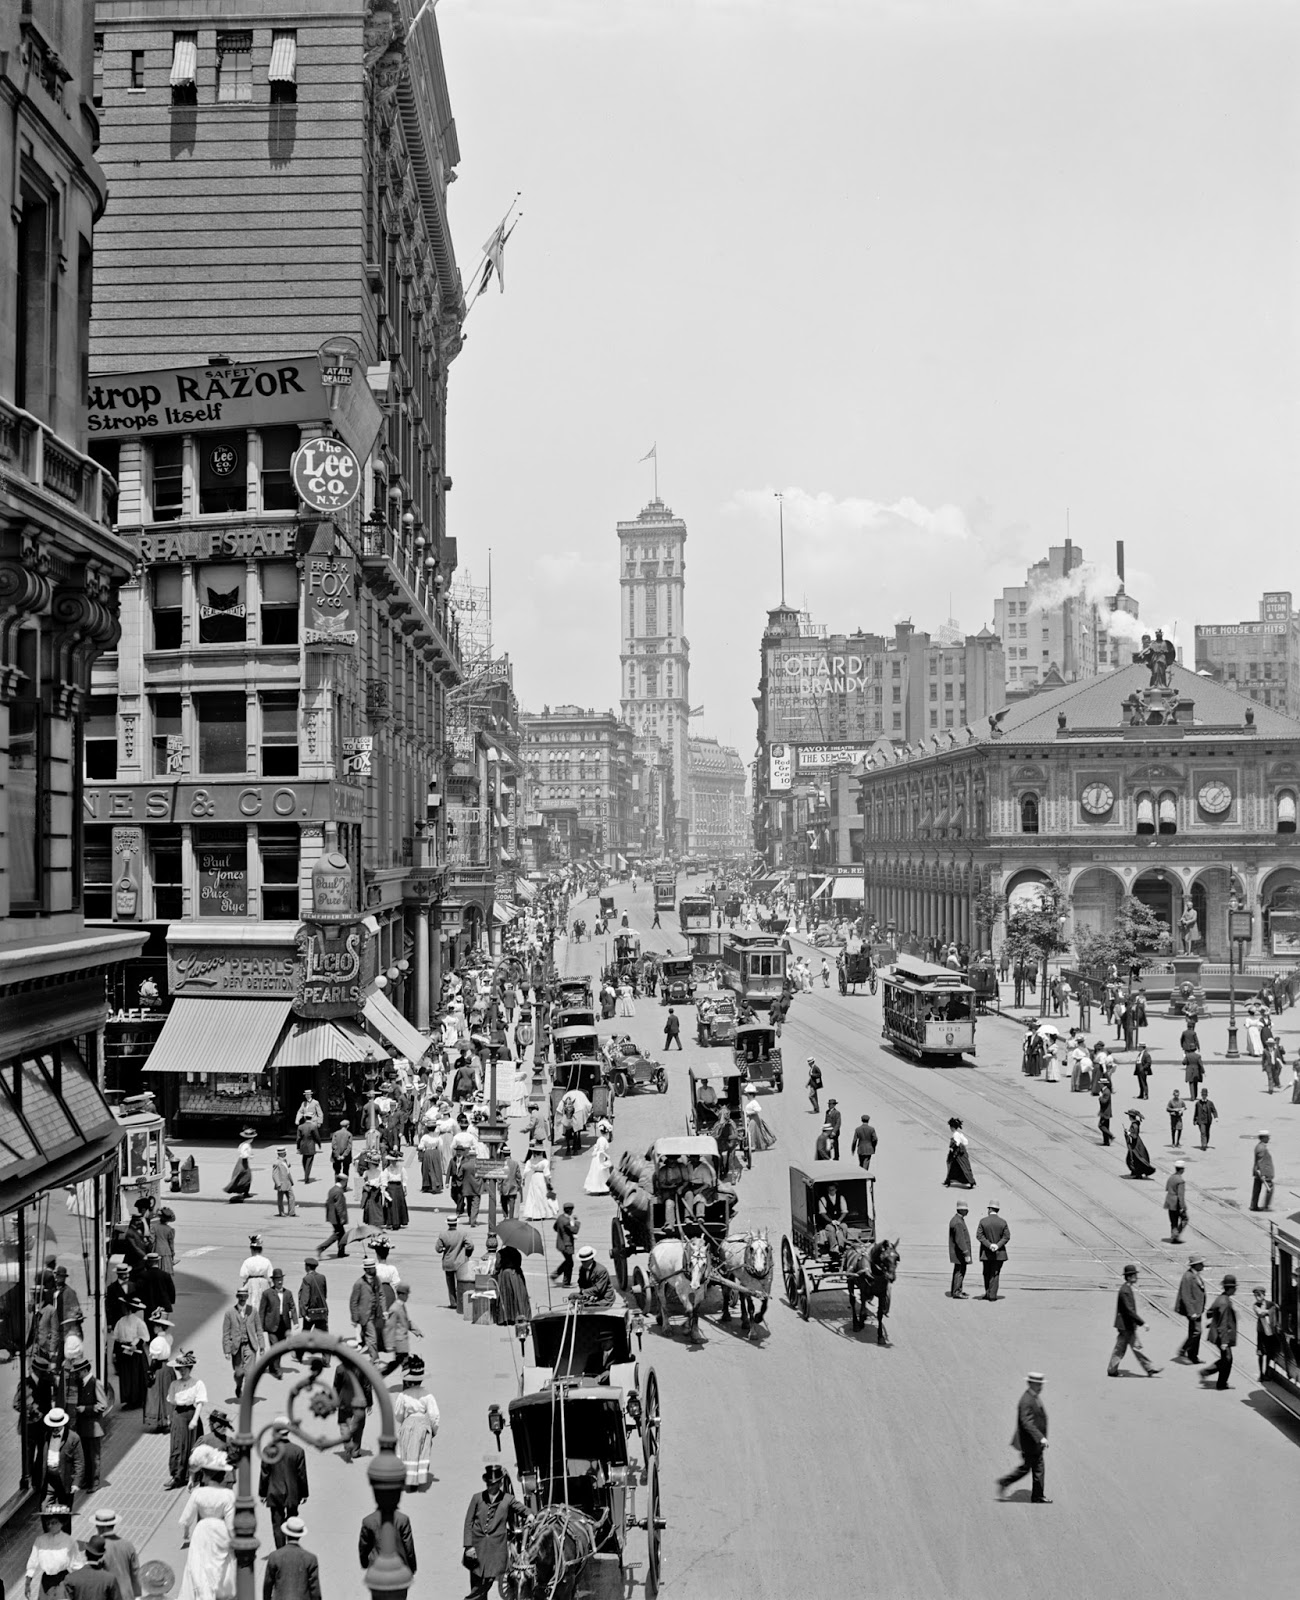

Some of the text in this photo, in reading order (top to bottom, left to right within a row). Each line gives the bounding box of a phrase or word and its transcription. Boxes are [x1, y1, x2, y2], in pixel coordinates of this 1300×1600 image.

[205, 367, 259, 379] SAFETY
[327, 367, 351, 375] AT ALL
[176, 366, 306, 402] RAZOR
[323, 375, 352, 384] DEALERS
[88, 402, 223, 431] Strops Itself
[317, 440, 342, 453] The
[213, 451, 234, 462] Lee
[303, 450, 354, 478] Lee
[138, 528, 299, 562] REAL ESTATE
[308, 572, 352, 598] FOX
[316, 597, 326, 607] &
[1266, 604, 1287, 612] STERN
[1200, 626, 1217, 635] THE
[1220, 626, 1249, 635] HOUSE
[1264, 624, 1284, 633] HITS
[785, 656, 863, 676] OTARD
[800, 677, 869, 693] BRANDY
[343, 751, 372, 775] FOX
[802, 755, 817, 763] THE
[190, 789, 215, 817] &
[238, 788, 308, 816] CO.
[203, 853, 231, 867] Paul
[208, 867, 244, 889] Jones
[315, 876, 339, 889] Paul
[201, 885, 229, 899] Pure
[220, 898, 245, 916] Rye
[230, 957, 295, 976] PEARLS
[223, 976, 293, 991] DEFY DETECTION
[303, 985, 360, 1004] PEARLS
